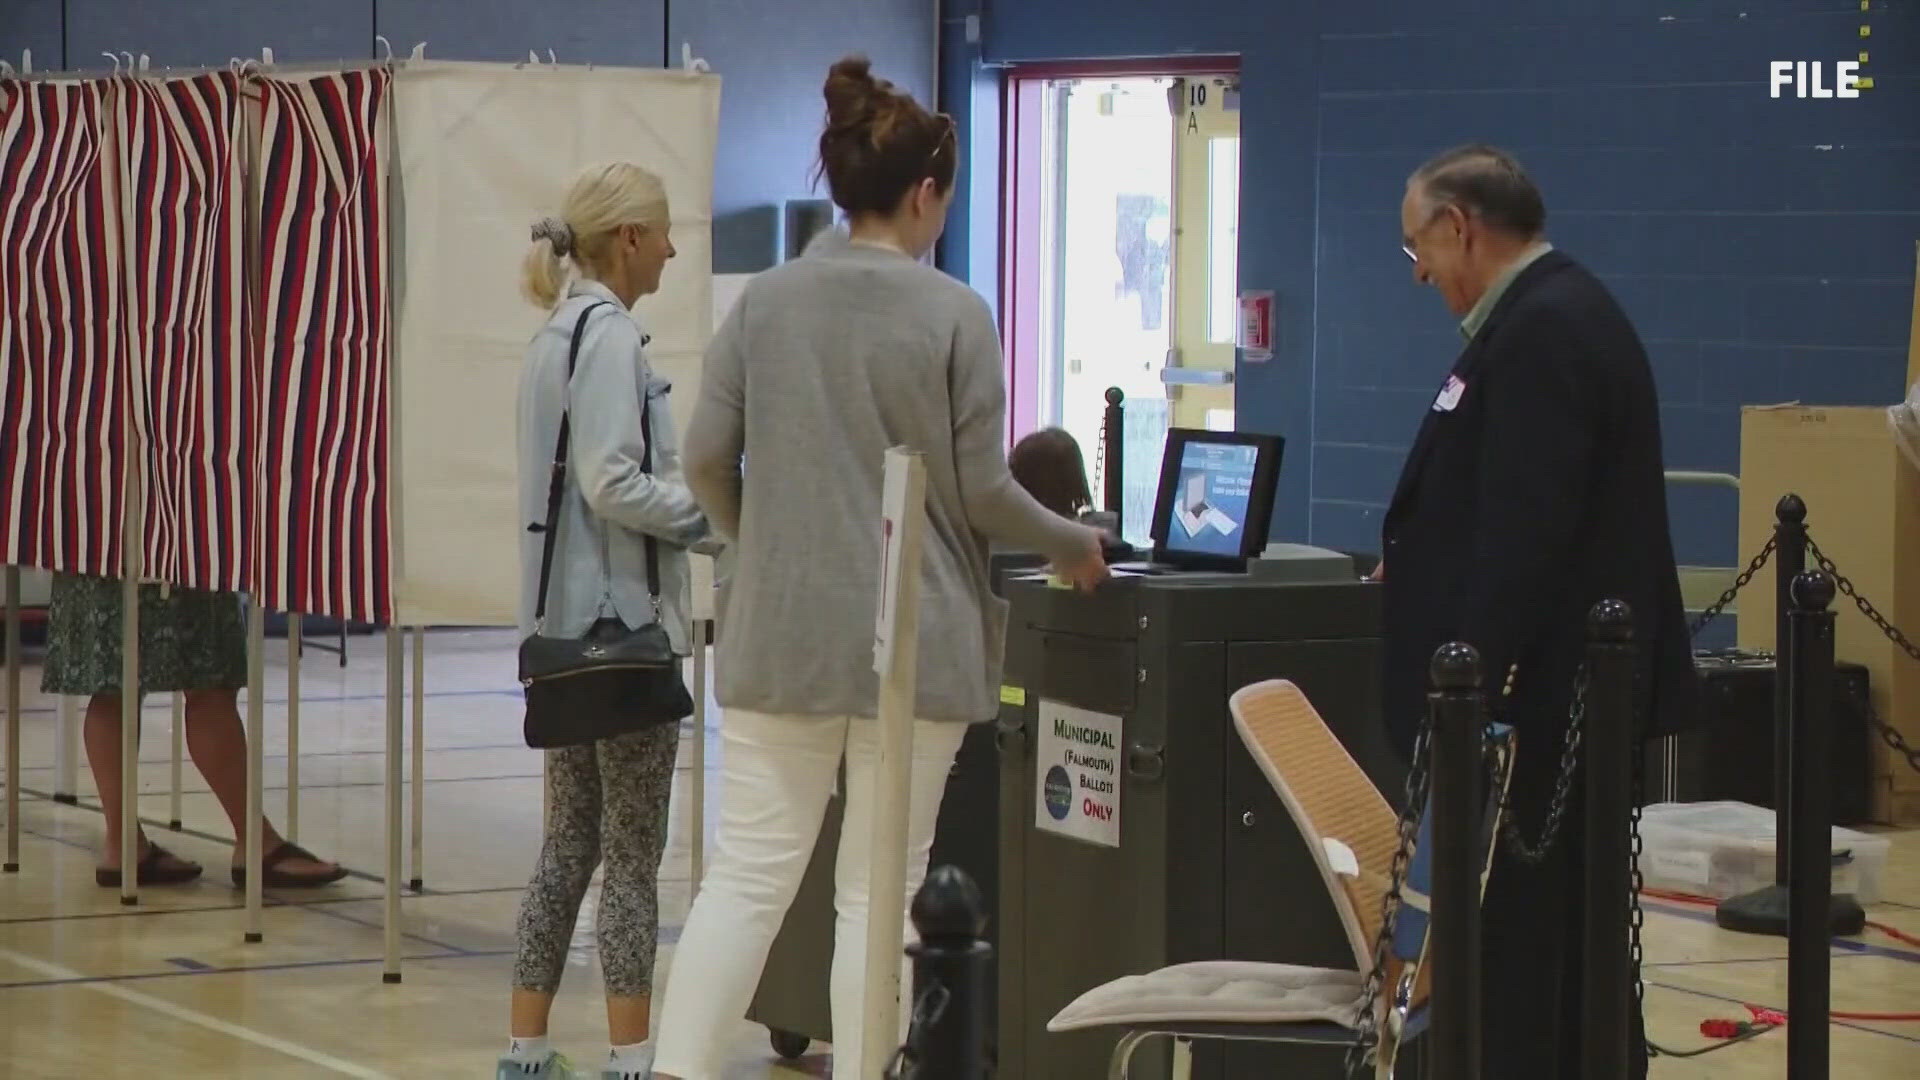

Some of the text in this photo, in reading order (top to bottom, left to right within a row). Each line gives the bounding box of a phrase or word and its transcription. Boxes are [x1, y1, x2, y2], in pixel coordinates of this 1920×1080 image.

[1190, 84, 1206, 106] 10
[1186, 111, 1199, 135] A
[1054, 719, 1115, 749] MUNICIPAL
[1064, 749, 1114, 775] (FALMOUTH)
[1083, 797, 1113, 821] ONLY
